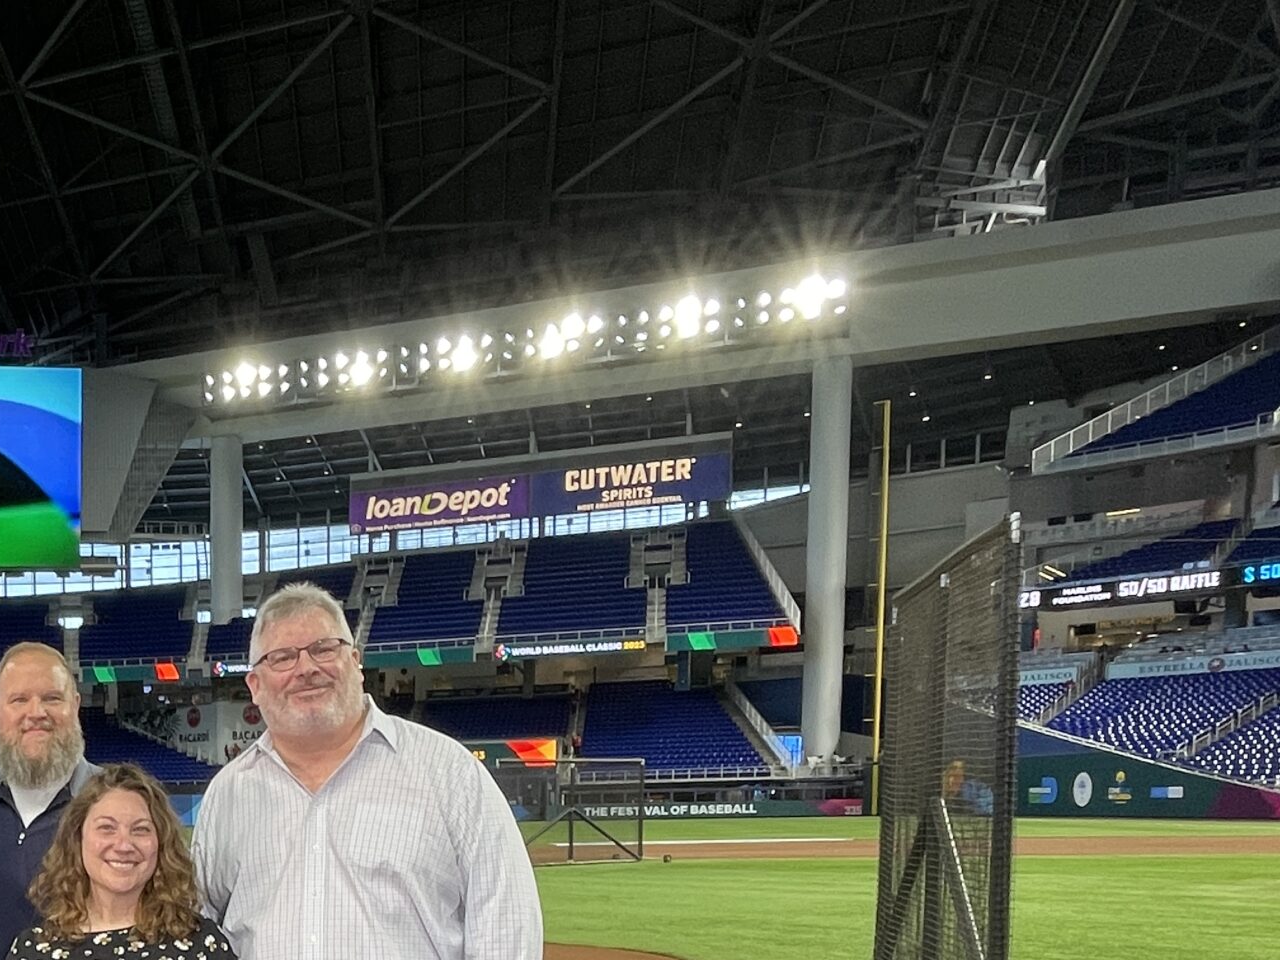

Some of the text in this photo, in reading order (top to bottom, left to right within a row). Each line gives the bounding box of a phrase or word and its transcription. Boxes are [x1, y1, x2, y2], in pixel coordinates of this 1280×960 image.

[565, 458, 692, 492] CUTWATER
[365, 482, 511, 520] loanDepot
[601, 486, 653, 502] SPIRITS
[1170, 571, 1221, 590] RAFFLE
[511, 647, 542, 656] WORLD
[543, 644, 584, 655] BASEBALL
[586, 642, 622, 652] CLASSIC
[584, 803, 758, 817] THE FESTVAL OF BASEBALL
